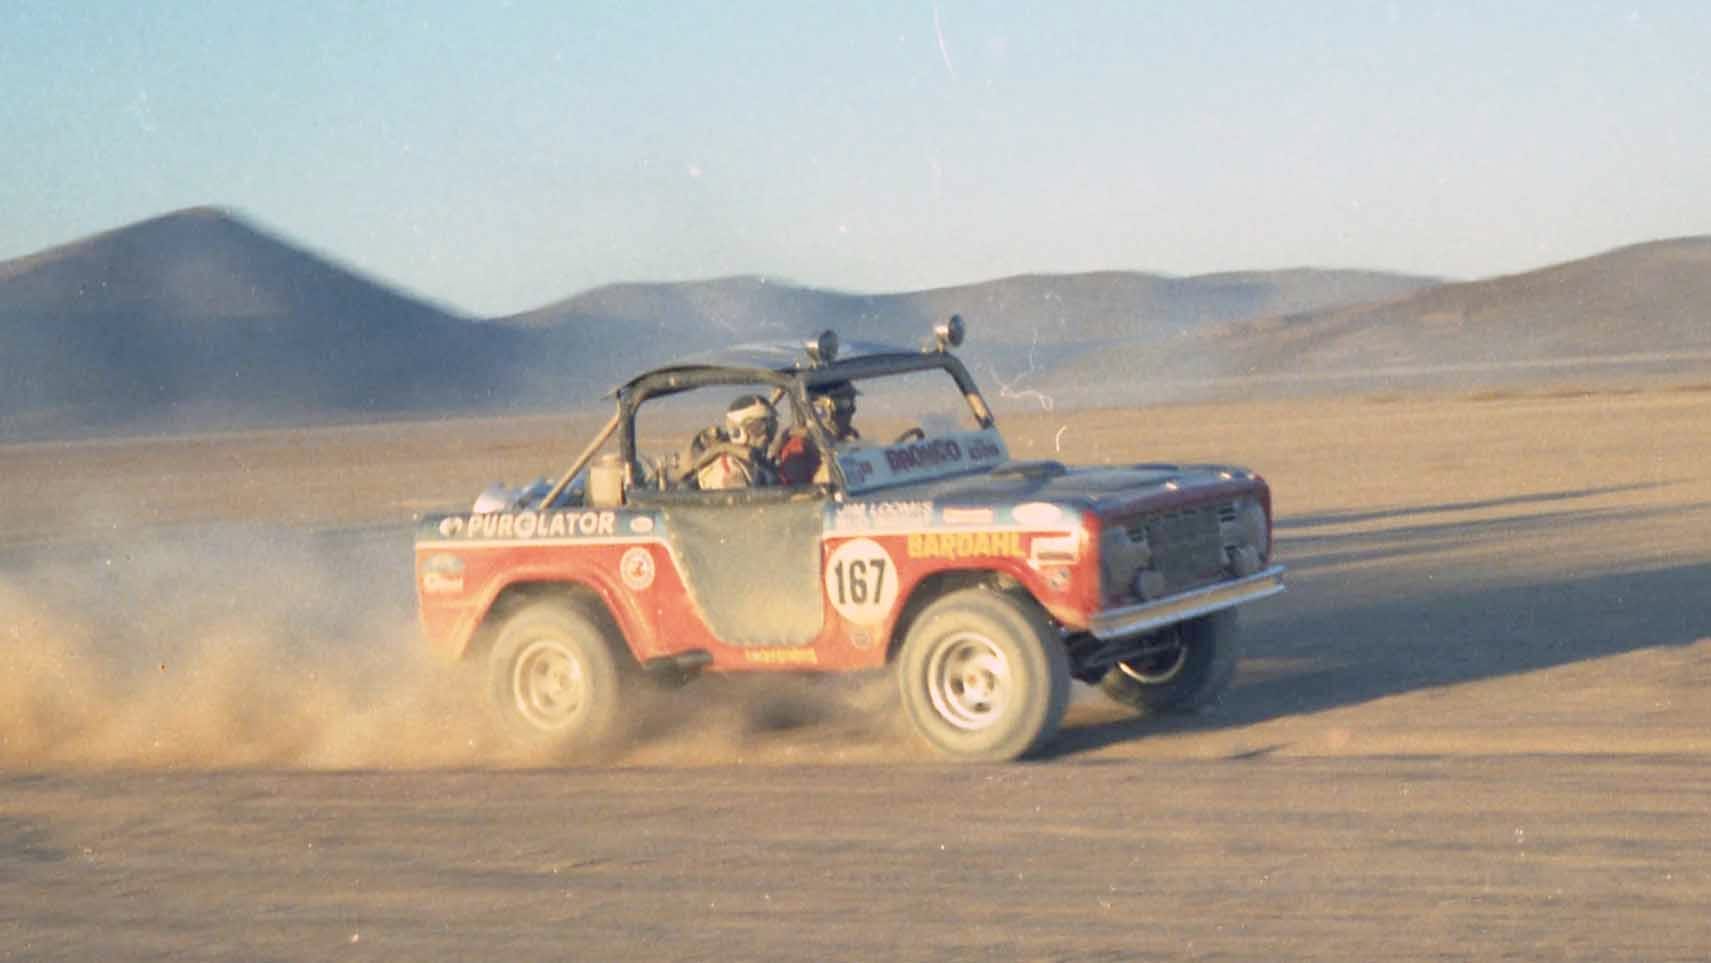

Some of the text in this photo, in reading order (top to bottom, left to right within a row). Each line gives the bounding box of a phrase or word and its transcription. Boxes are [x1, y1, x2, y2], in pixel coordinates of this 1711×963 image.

[467, 511, 615, 538] PUROLATOR
[908, 531, 1026, 558] BARDAHL
[834, 558, 886, 605] 167
